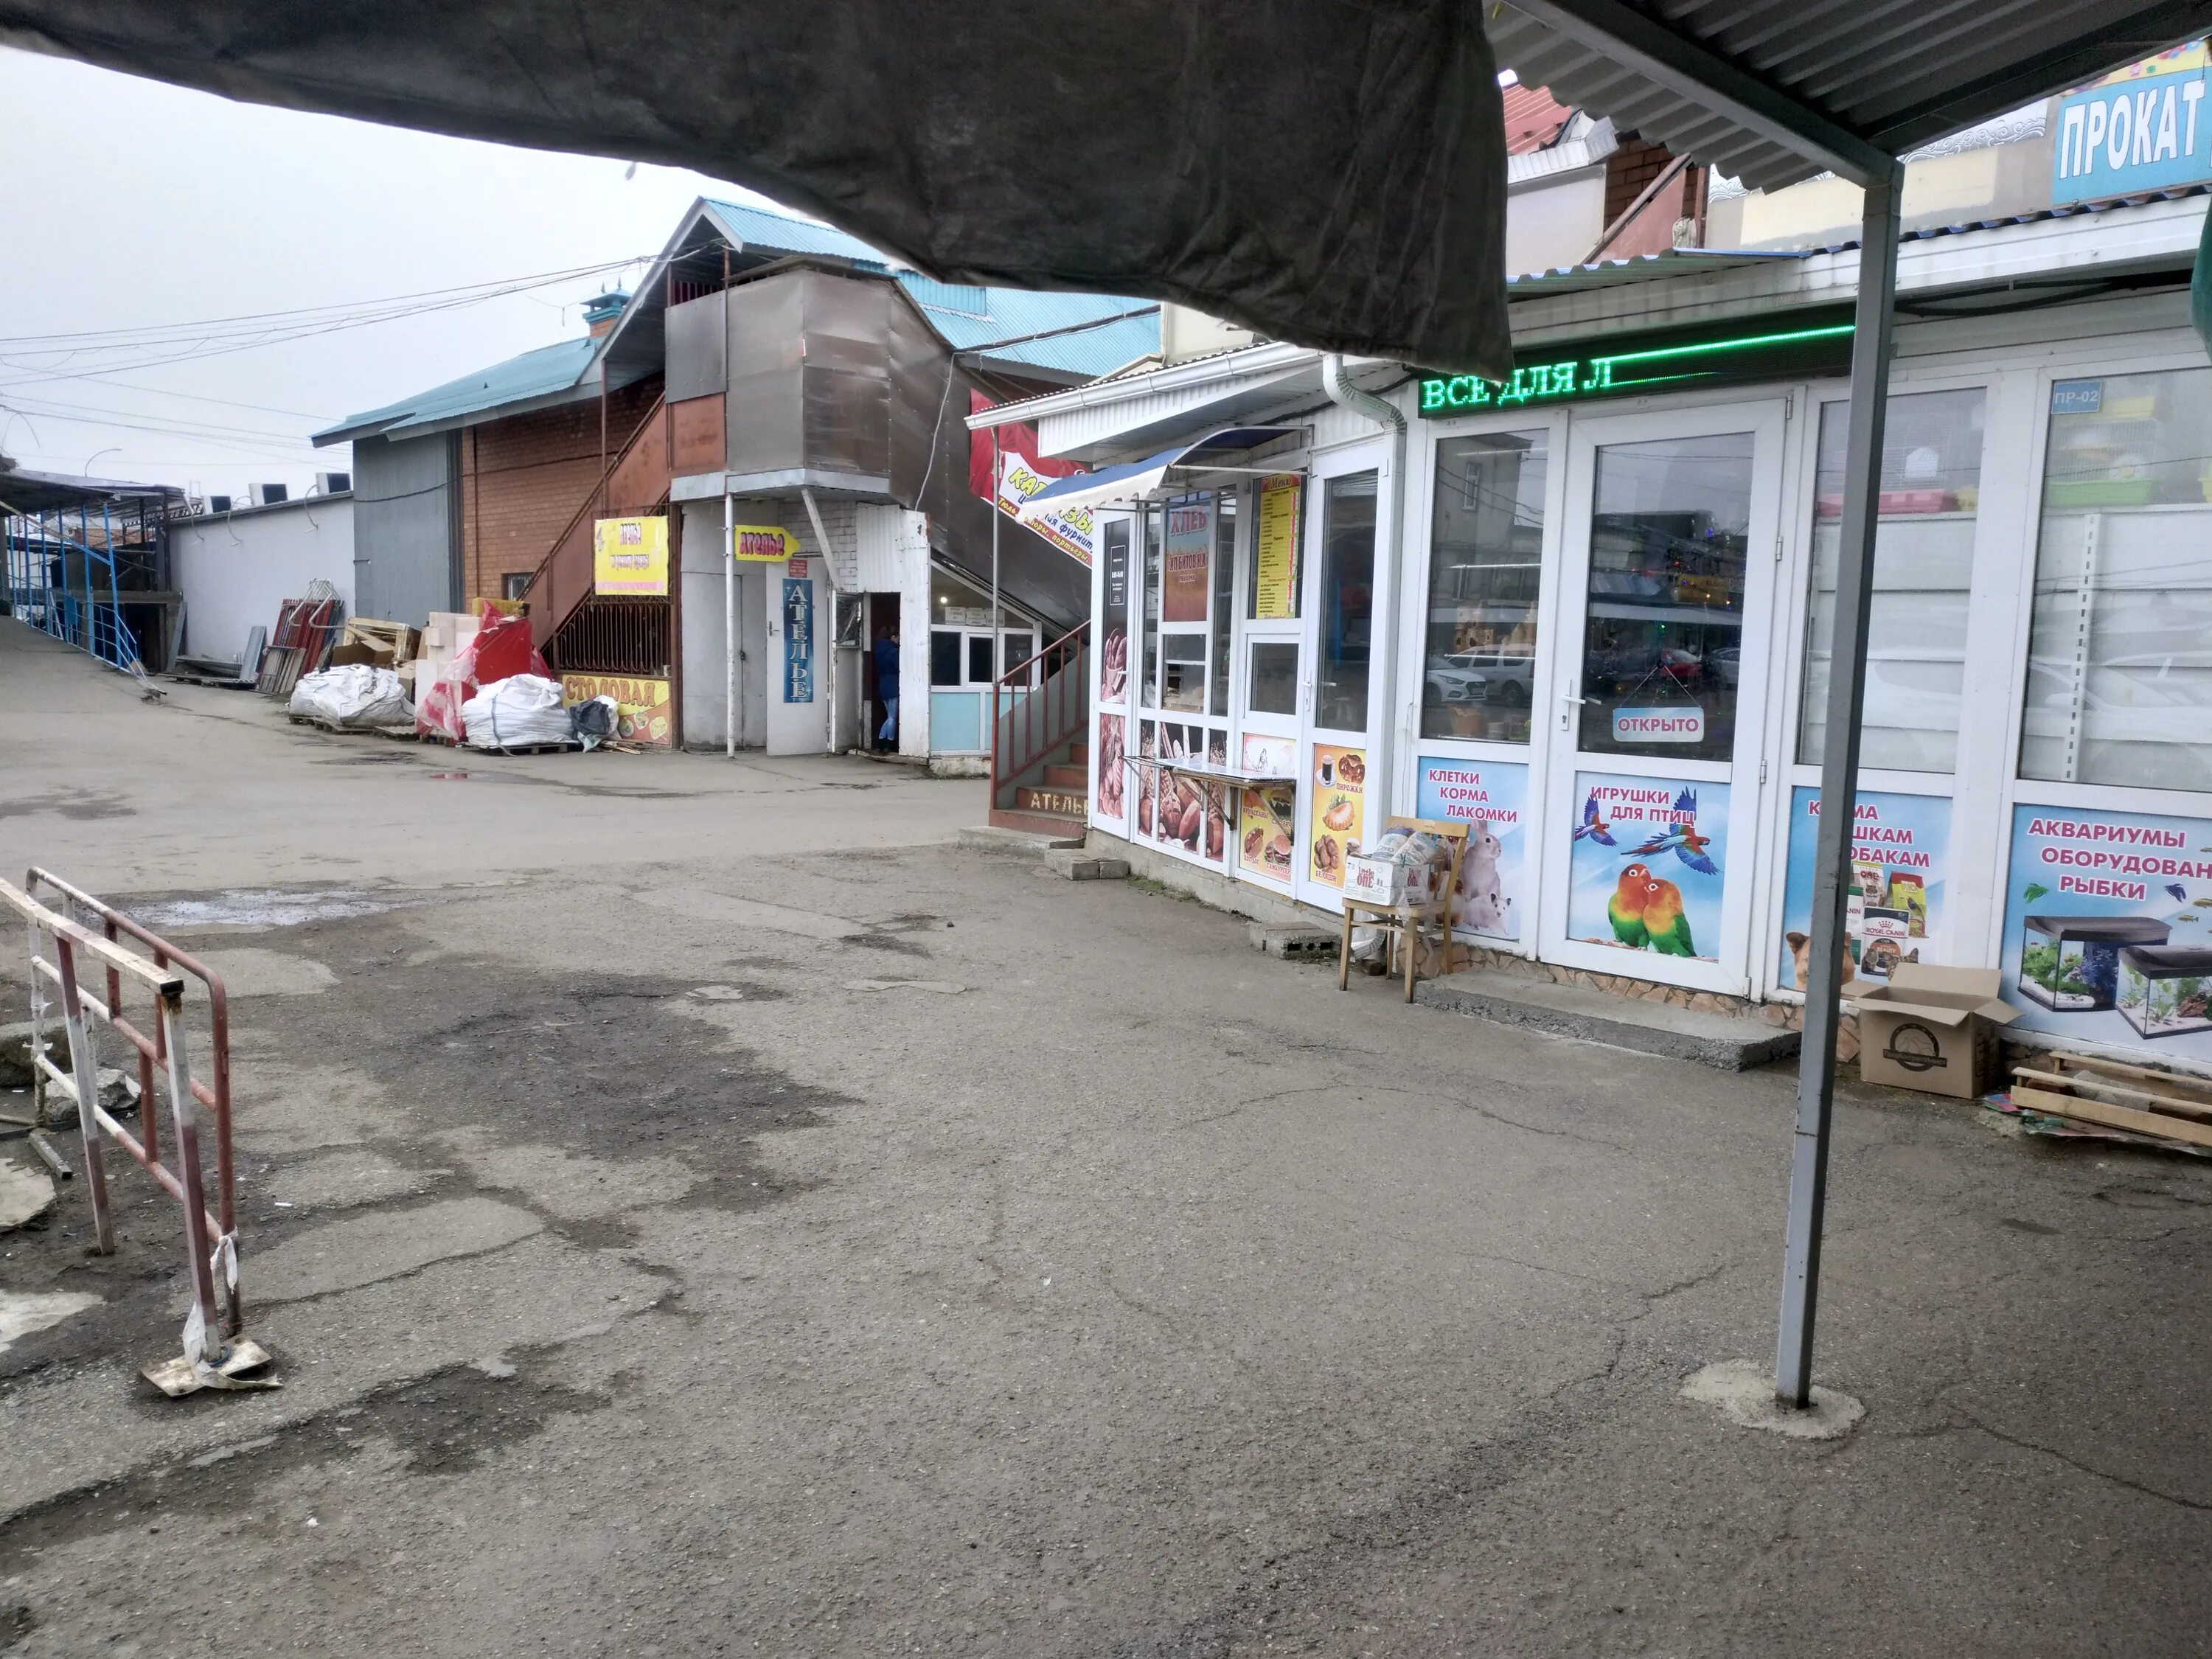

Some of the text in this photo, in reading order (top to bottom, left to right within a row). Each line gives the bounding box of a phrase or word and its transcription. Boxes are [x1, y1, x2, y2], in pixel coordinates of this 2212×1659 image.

[2059, 78, 2206, 180] ПРОКАТ
[1422, 375, 1490, 409] ВСЕ
[1498, 361, 1578, 406] ДЛЯ
[2054, 390, 2098, 404] ПР-02
[1270, 477, 1291, 489] Меню
[1059, 523, 1093, 553] фурнит
[788, 585, 808, 698] АТЕЛЬЕ
[565, 676, 655, 707] СТОЛОВАЯ
[1618, 717, 1699, 732] ОТКРЫТО
[1429, 769, 1480, 785] КЛЕТКИ
[1336, 782, 1363, 794] ПИРОЖКИ
[1439, 787, 1489, 802] КОРМА
[1590, 786, 1670, 804] ИГРУШКИ
[1446, 804, 1517, 823] ЛАКОМКИ
[1610, 805, 1695, 827] ДЛЯ ПТИЦ
[1809, 801, 1879, 820] КМА
[1851, 826, 1913, 844] ШКАМ
[2028, 819, 2185, 848] АКВАРИУМЫ
[1851, 846, 1930, 868] ОБАКАМ
[1315, 869, 1337, 883] БЕЛЯШИ
[2060, 875, 2146, 900] РЫБКИ
[1866, 927, 1885, 935] ROYAL
